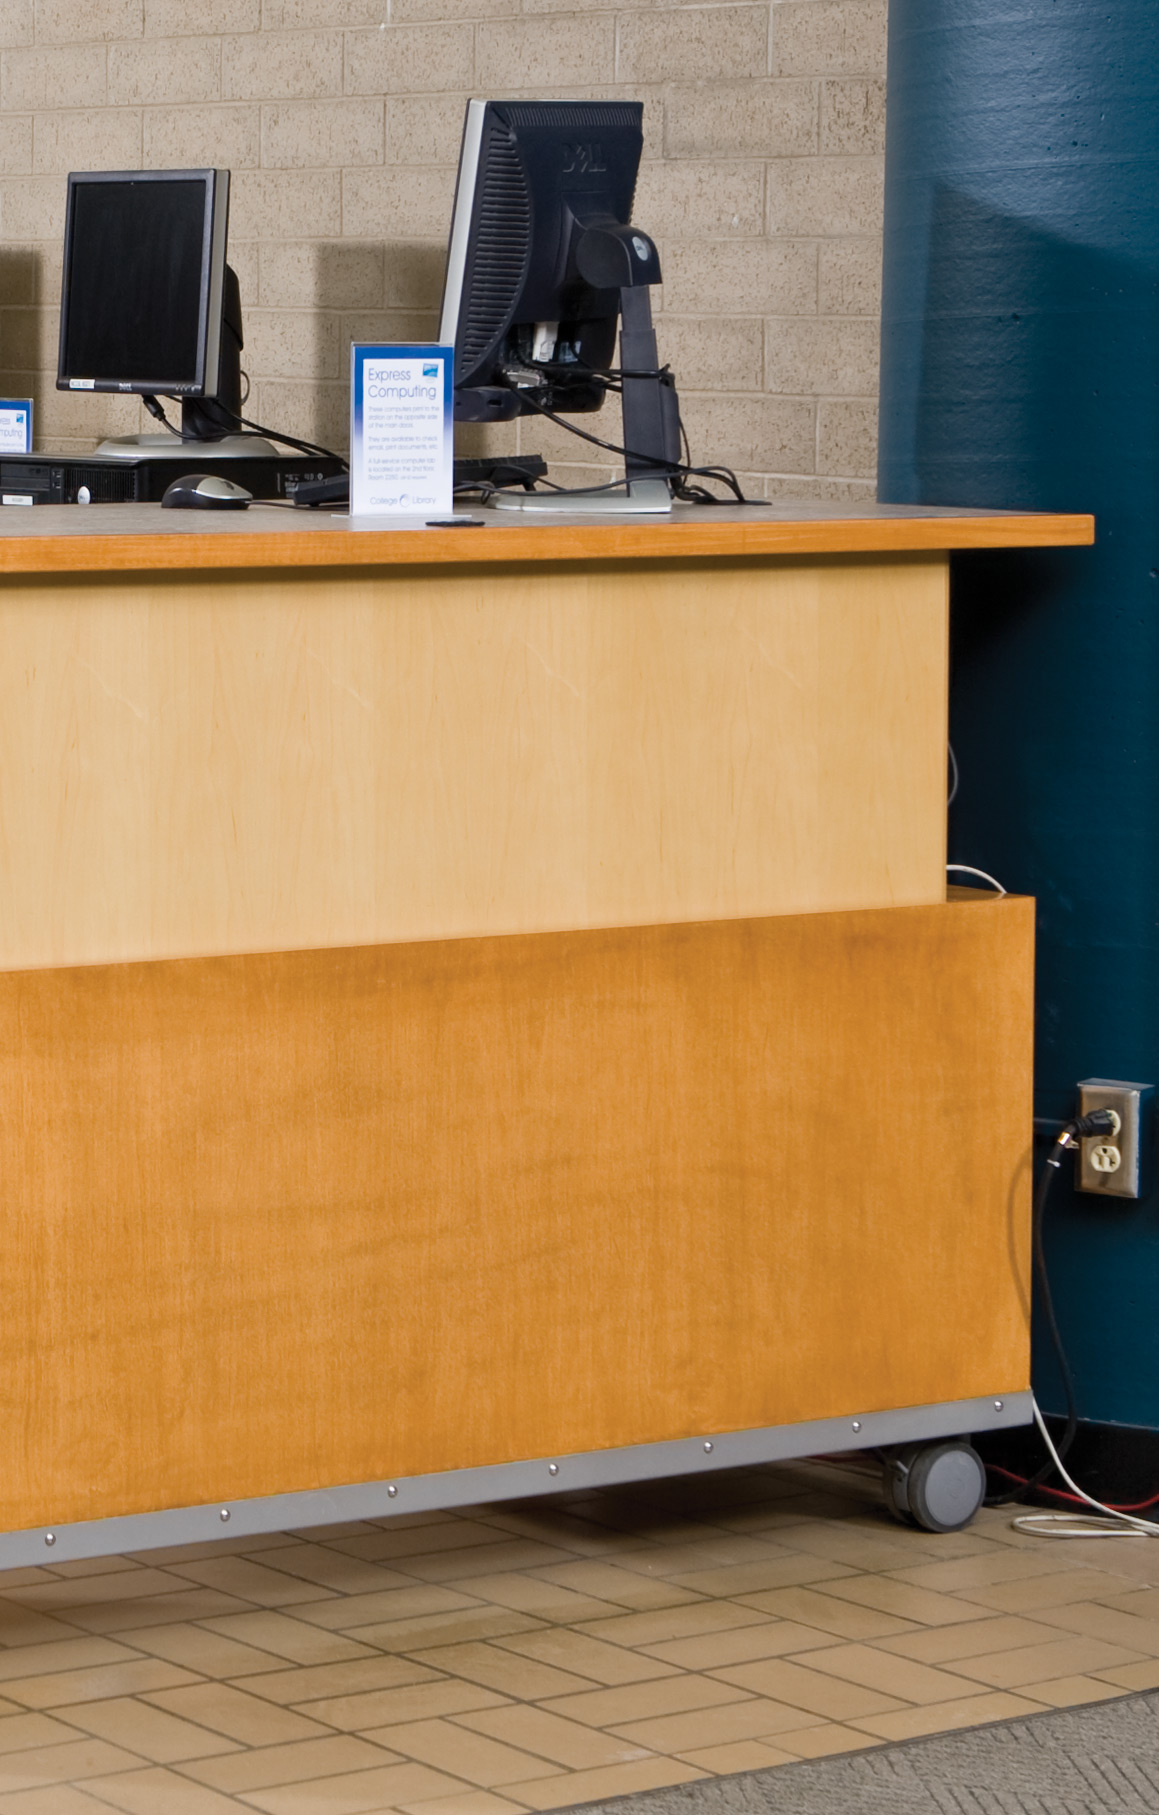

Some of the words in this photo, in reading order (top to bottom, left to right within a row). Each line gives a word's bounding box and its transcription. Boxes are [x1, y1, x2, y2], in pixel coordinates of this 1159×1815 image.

[368, 367, 411, 383] Express
[368, 384, 437, 401] Computing
[369, 496, 398, 506] College
[412, 496, 437, 505] Library
